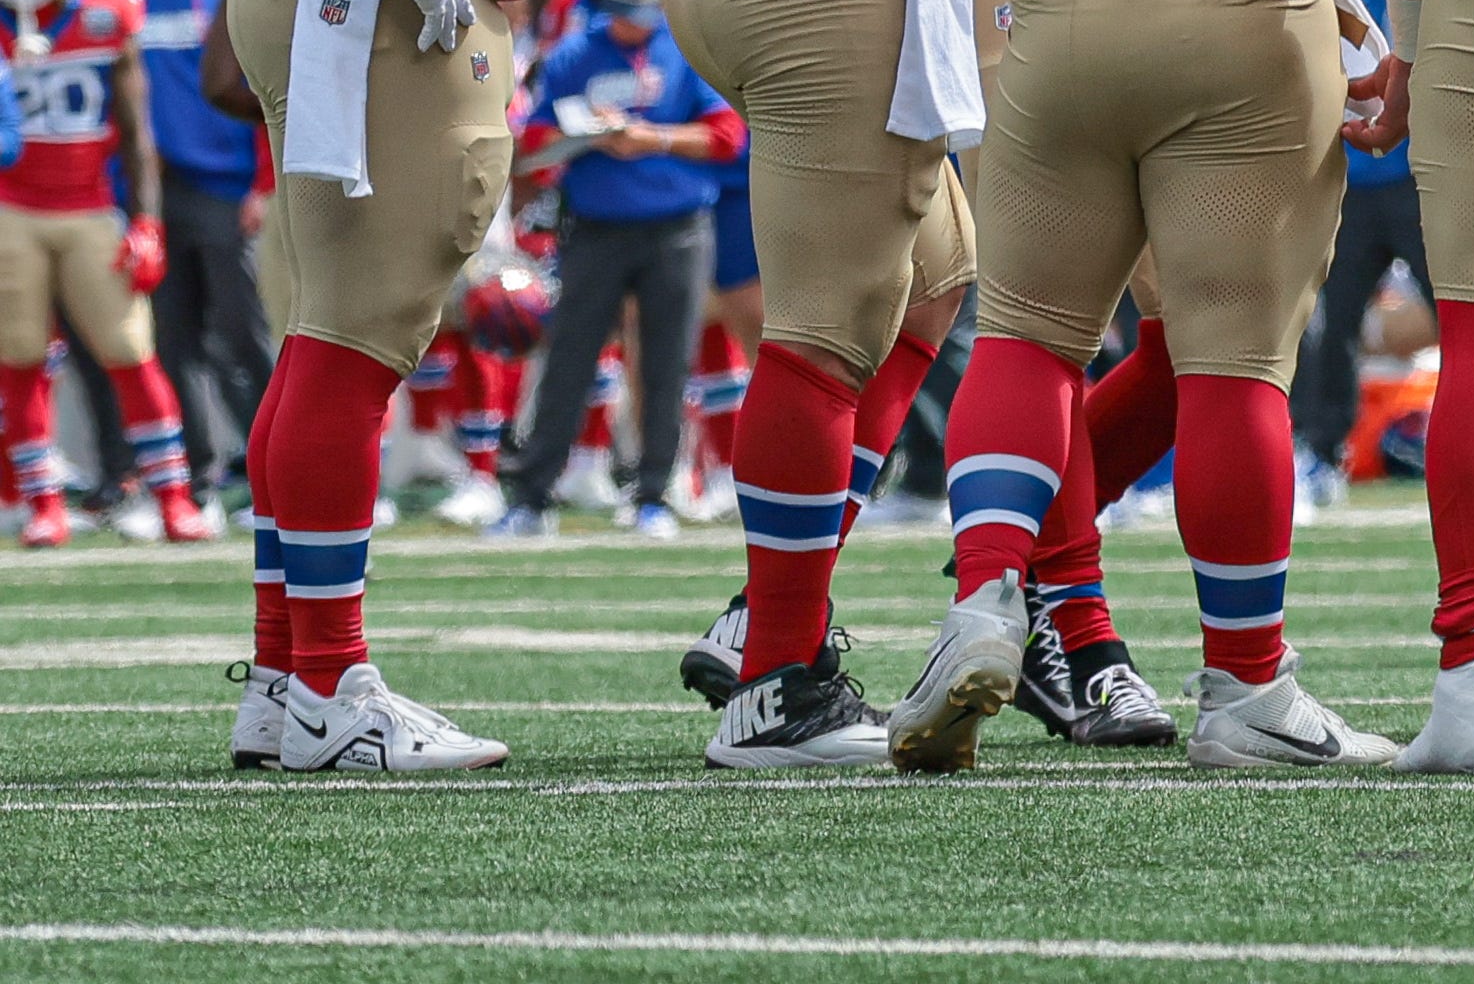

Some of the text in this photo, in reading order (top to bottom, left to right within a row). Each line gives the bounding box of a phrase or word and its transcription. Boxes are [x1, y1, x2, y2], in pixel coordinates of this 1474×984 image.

[708, 607, 749, 649] NI
[717, 677, 786, 747] NIKE
[341, 750, 379, 767] ALPHA
